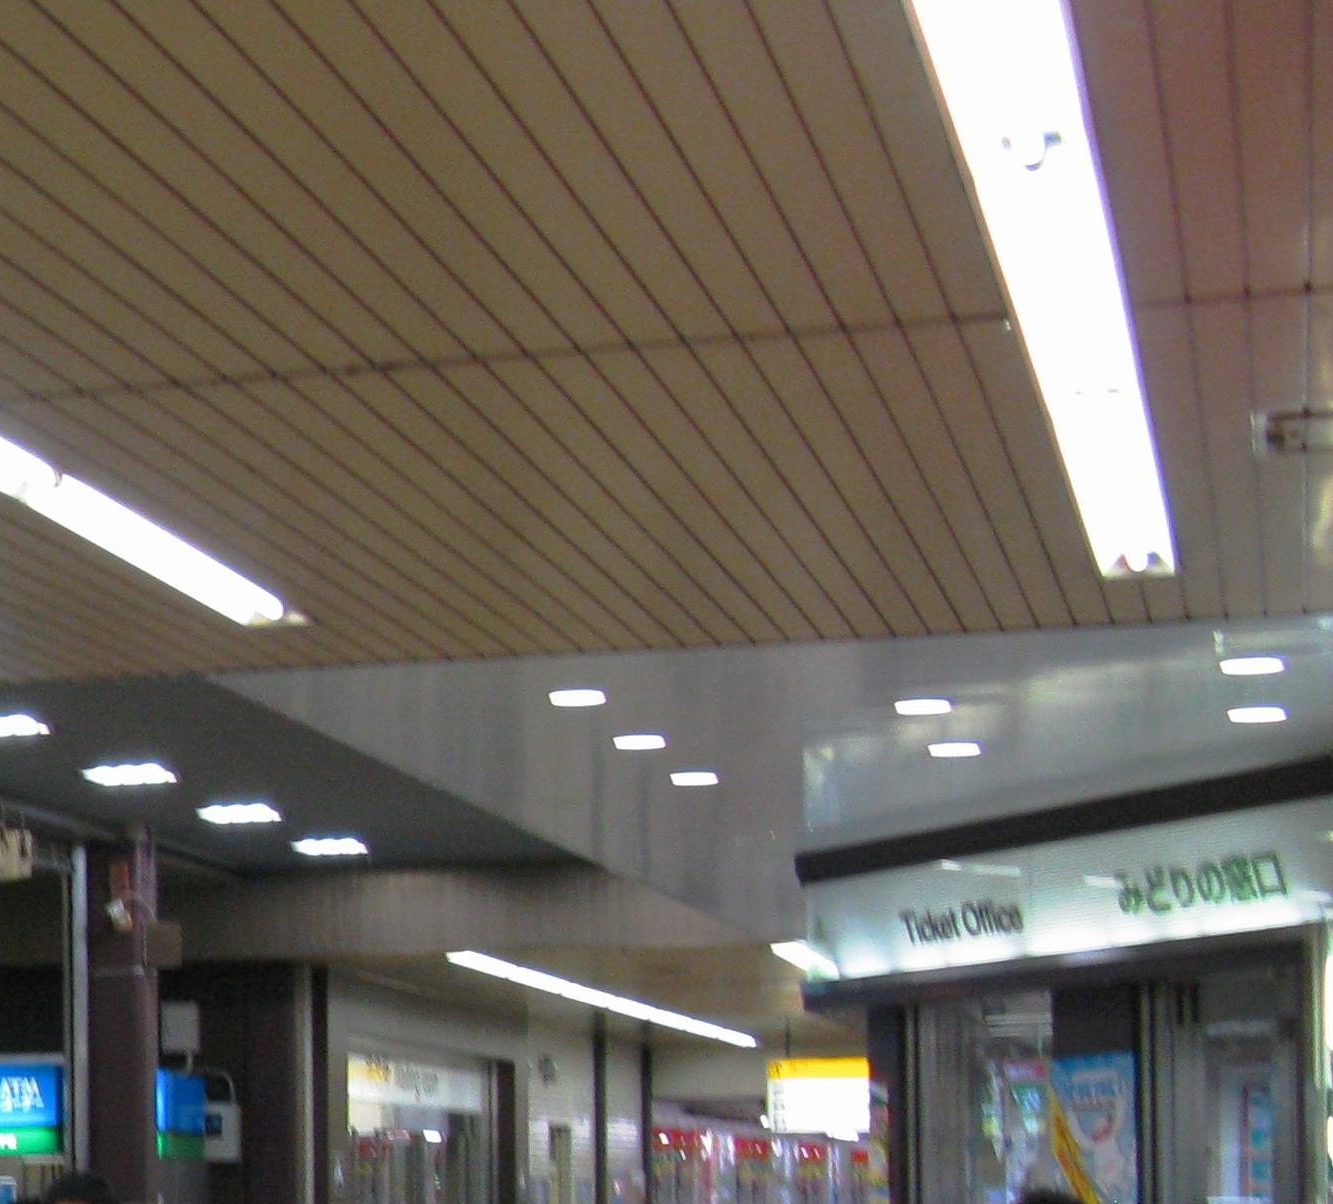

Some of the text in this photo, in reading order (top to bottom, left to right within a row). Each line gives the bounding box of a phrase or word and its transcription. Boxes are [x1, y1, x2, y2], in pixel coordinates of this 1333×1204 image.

[1117, 852, 1287, 914] みどりの窓口
[900, 899, 1025, 946] Ticket Office
